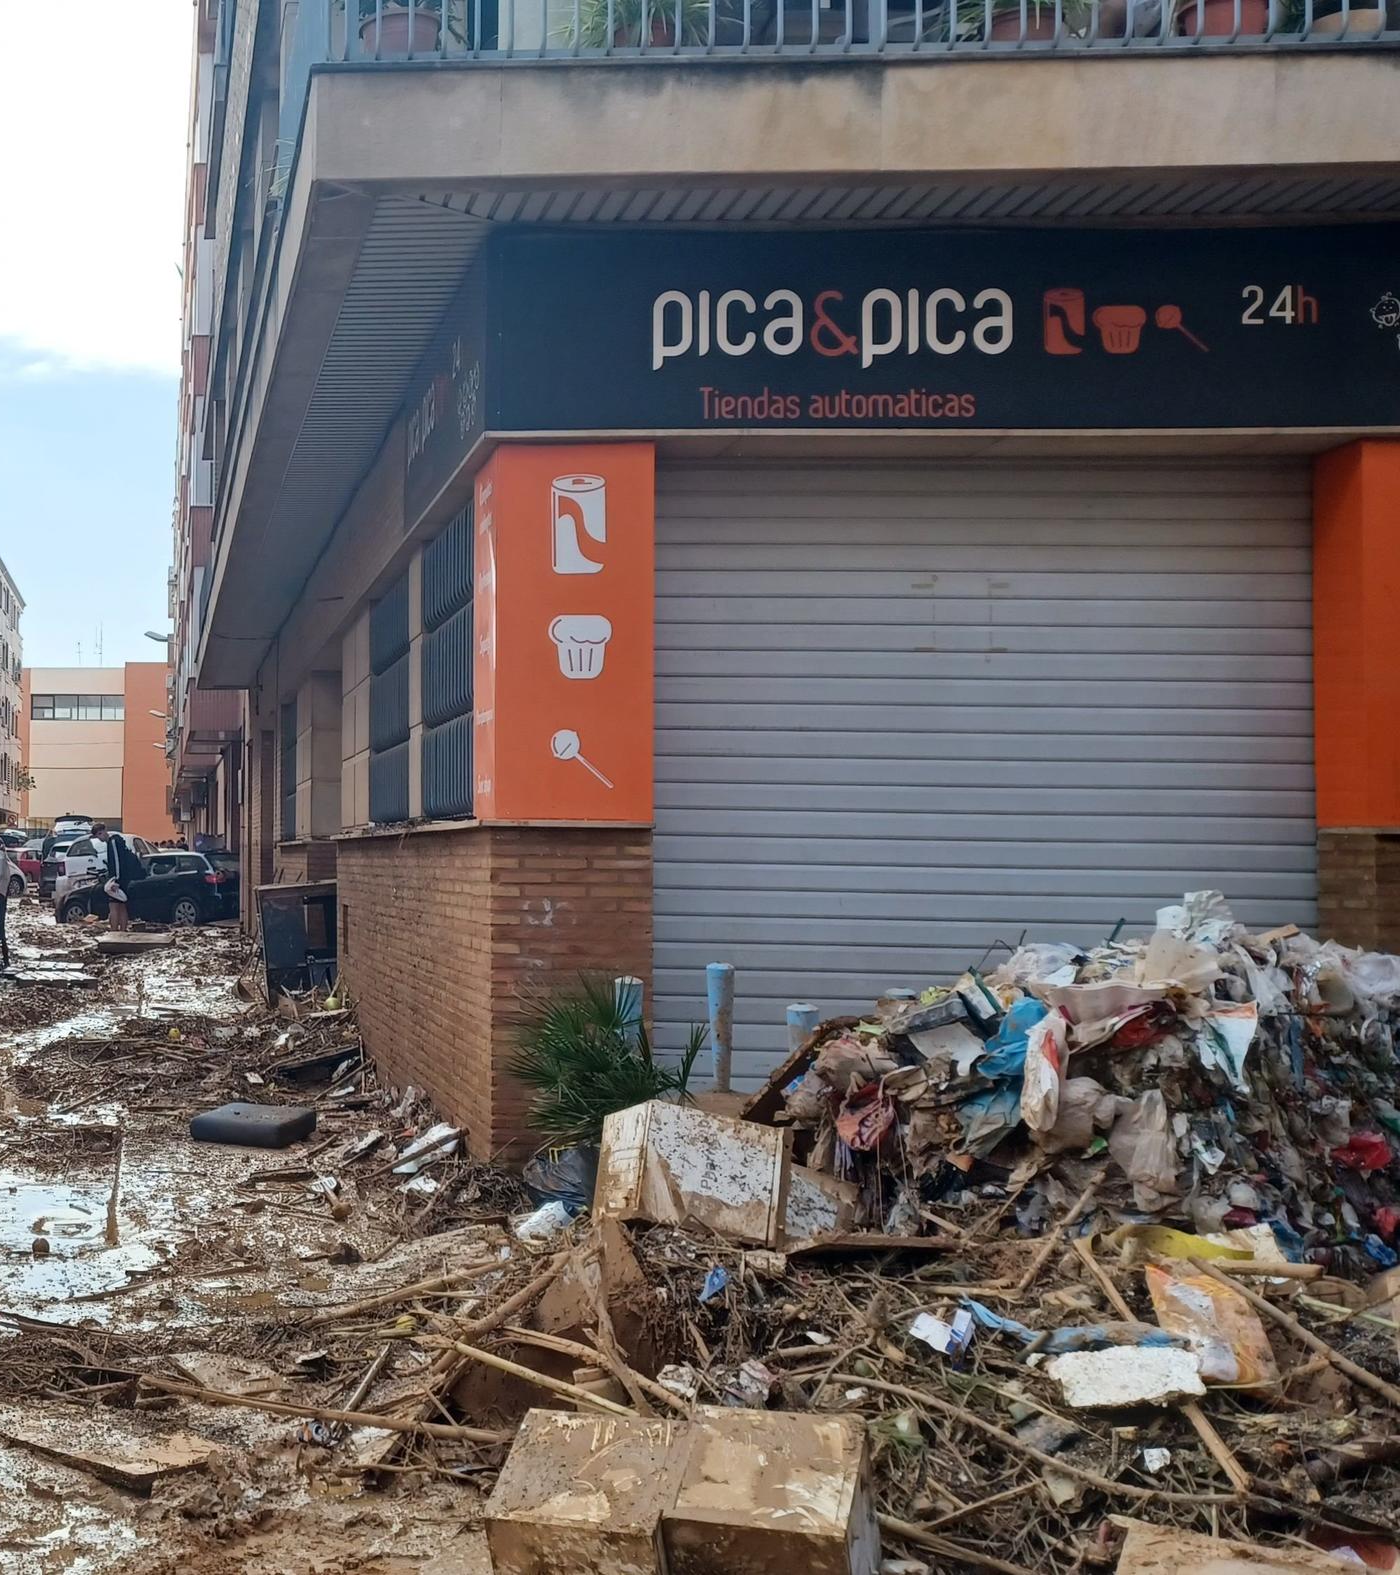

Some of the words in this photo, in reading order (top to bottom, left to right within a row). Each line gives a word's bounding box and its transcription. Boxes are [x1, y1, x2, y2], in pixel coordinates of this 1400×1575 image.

[1241, 284, 1319, 325] 24h
[652, 287, 1014, 371] pica&pica
[699, 385, 801, 420] Tiendas
[808, 387, 976, 419] automaticas
